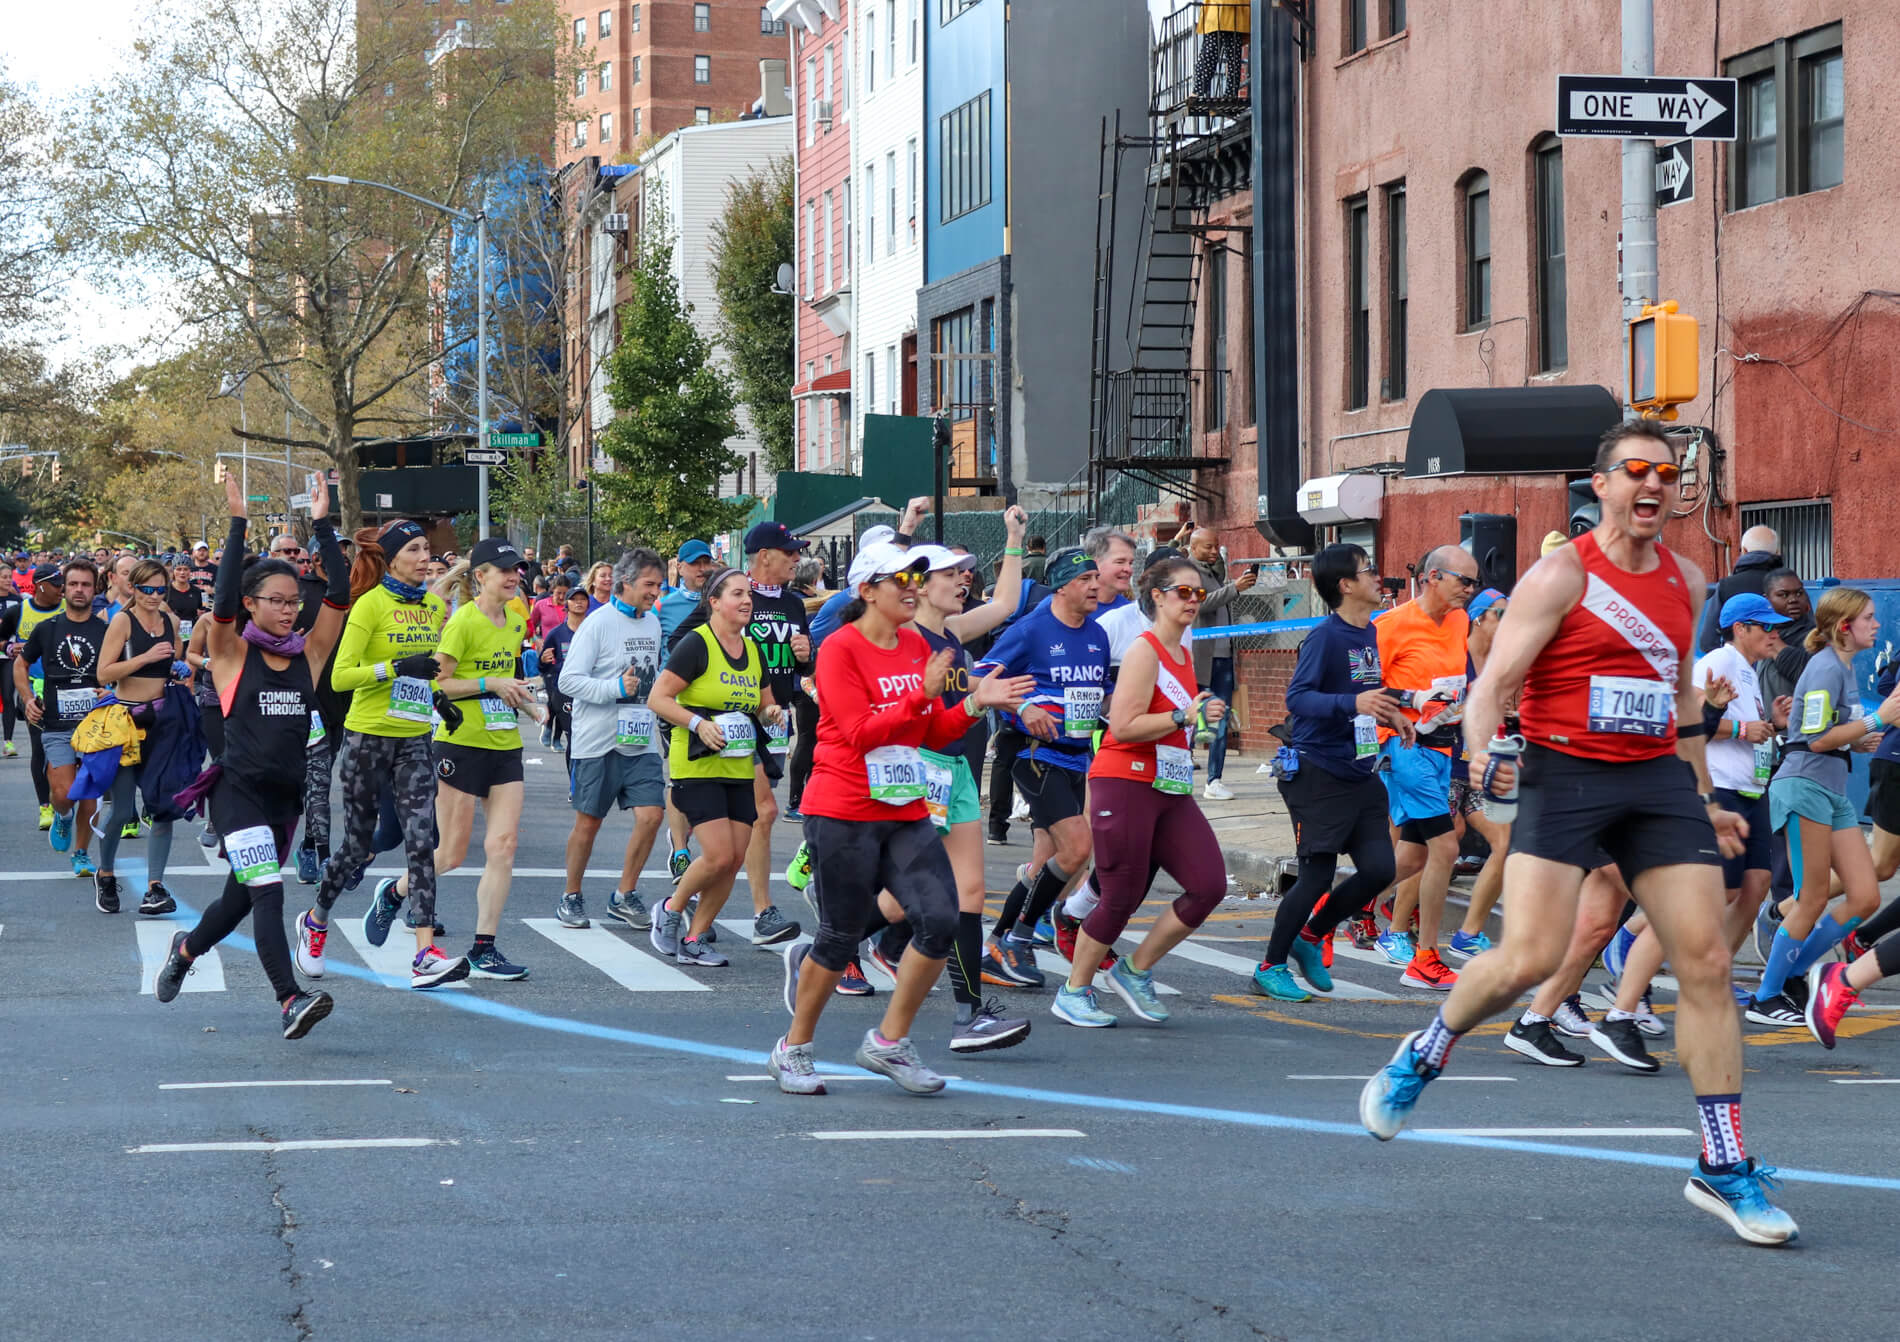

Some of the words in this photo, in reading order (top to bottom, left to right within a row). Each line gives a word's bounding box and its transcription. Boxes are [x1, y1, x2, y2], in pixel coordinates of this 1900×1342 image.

[1584, 95, 1633, 118] ONE
[1657, 97, 1709, 119] WAY
[1663, 160, 1683, 185] WAY
[491, 433, 529, 445] Skillman
[1427, 456, 1441, 474] 1038
[393, 608, 434, 625] CINDY
[387, 632, 422, 643] TEAM
[474, 660, 505, 671] TEAM
[720, 671, 758, 688] CARLA
[64, 698, 92, 713] 55520
[259, 691, 301, 704] COMING
[1612, 690, 1655, 718] 7040
[258, 703, 306, 716] THROUGH
[883, 764, 915, 784] 51061
